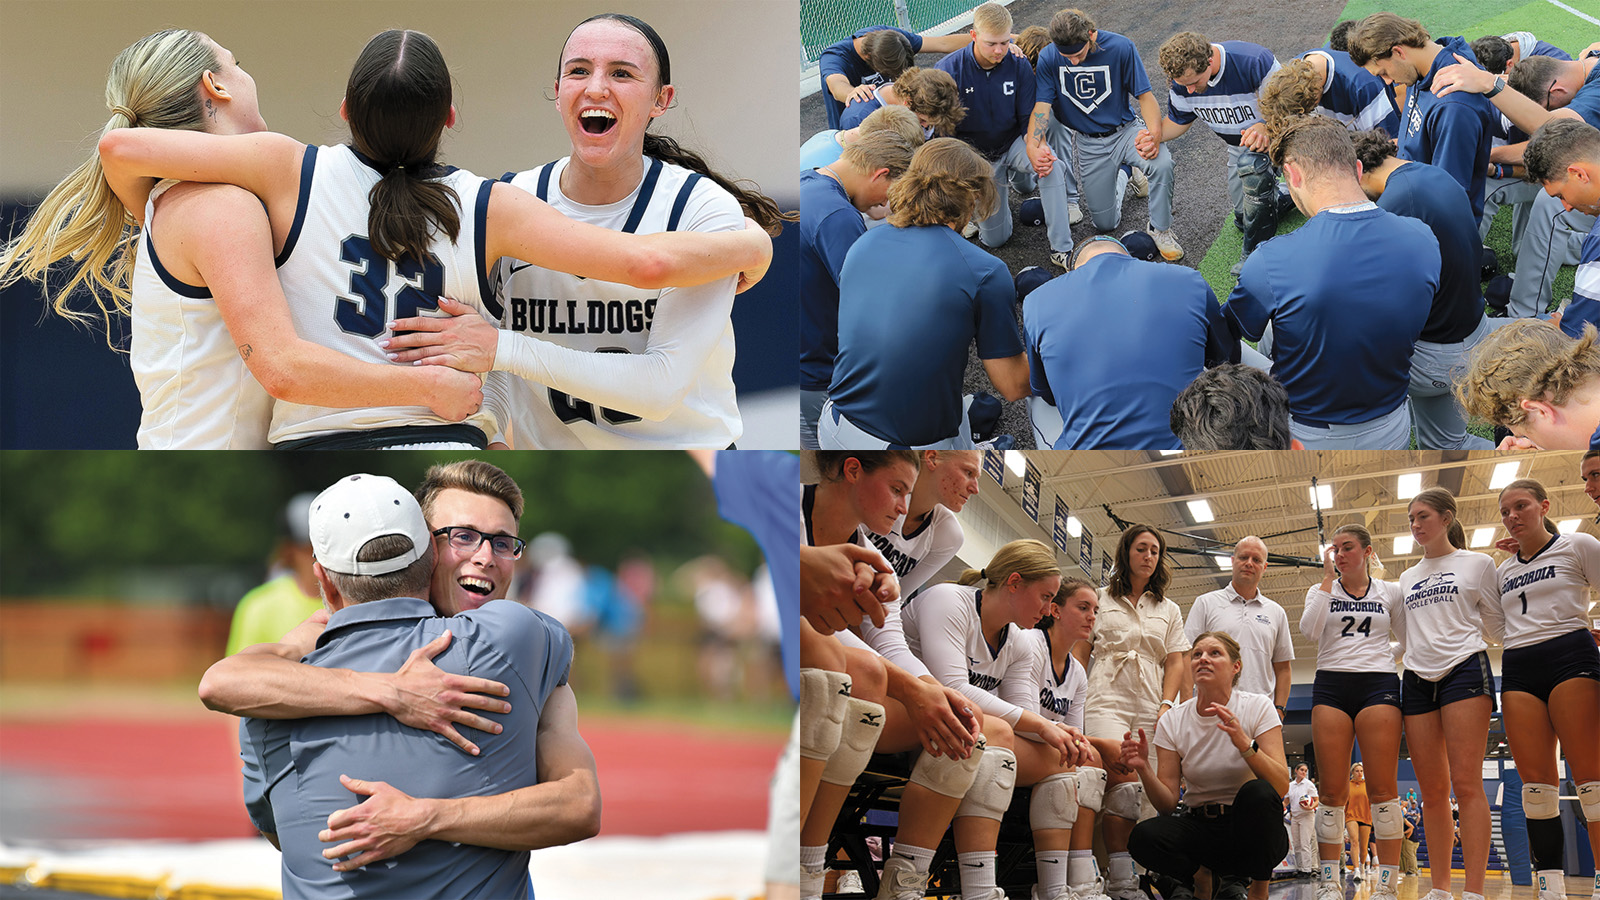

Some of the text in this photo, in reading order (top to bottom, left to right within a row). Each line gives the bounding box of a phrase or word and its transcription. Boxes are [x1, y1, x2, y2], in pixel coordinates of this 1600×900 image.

[1003, 81, 1015, 96] C
[1074, 73, 1097, 99] C
[333, 232, 446, 342] 32
[510, 297, 657, 335] BULLDOGS
[1405, 585, 1459, 605] CONCORDIA
[1408, 595, 1454, 611] VOLLEYBALL
[1518, 591, 1528, 615] 1
[1330, 600, 1385, 614] CONCORDIA
[1341, 616, 1372, 637] 24
